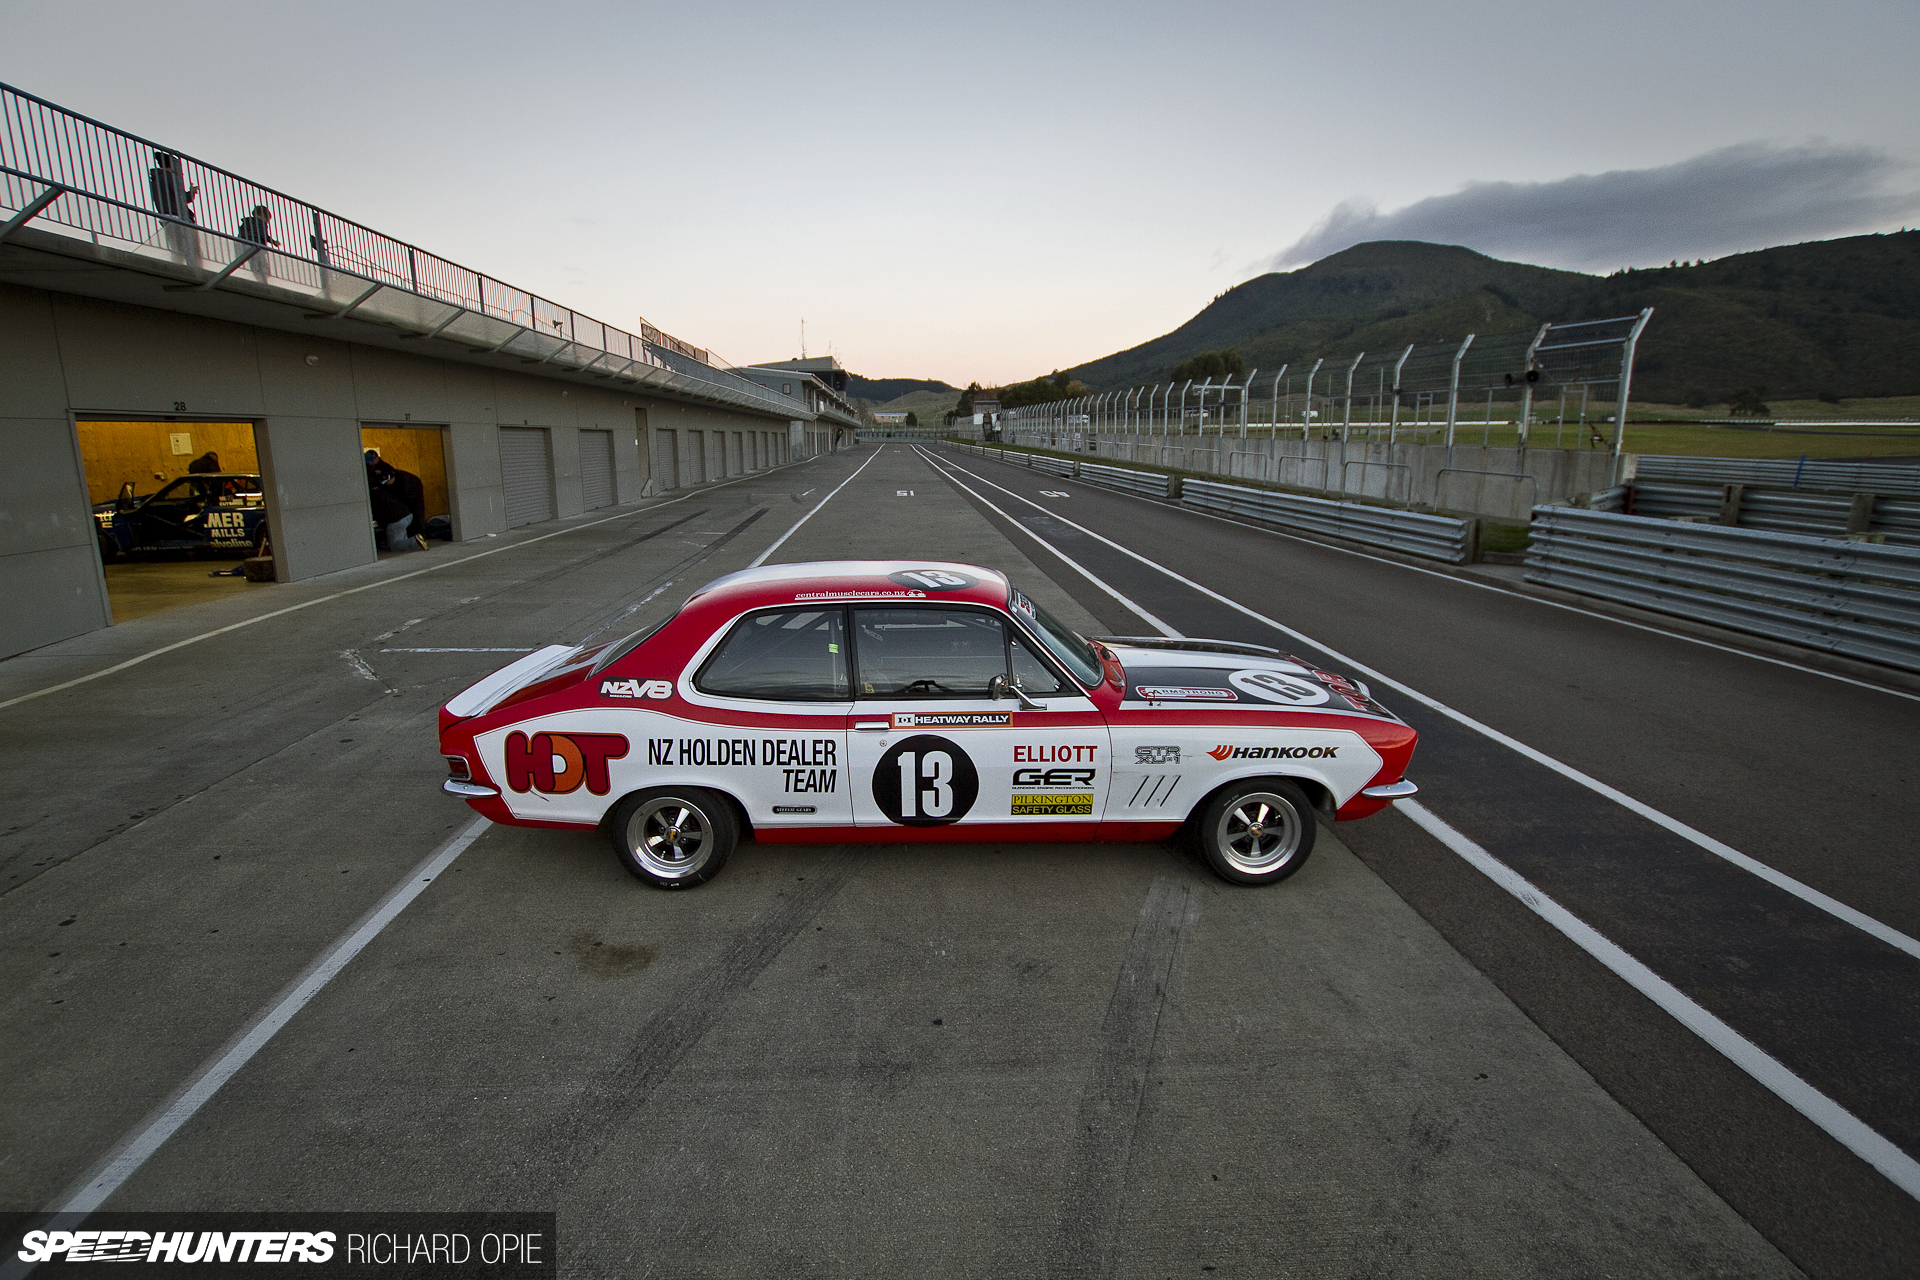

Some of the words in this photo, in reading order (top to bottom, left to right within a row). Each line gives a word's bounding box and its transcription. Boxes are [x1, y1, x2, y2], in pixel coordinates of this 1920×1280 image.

[174, 401, 187, 411] 28
[203, 512, 245, 528] MER
[211, 528, 245, 537] MILLS
[210, 539, 254, 548] alvoline
[902, 570, 966, 588] 13
[795, 590, 905, 598] centralmusclecars.co.nz
[1240, 674, 1317, 701] 13
[915, 716, 971, 724] HEATWAY
[972, 715, 1009, 723] RALLY
[648, 738, 674, 766] NZ
[679, 739, 756, 766] HOLDEN
[762, 739, 837, 766] DEALER
[1013, 745, 1098, 762] ELLIOTT
[1135, 746, 1181, 756] GTR
[504, 730, 629, 796] HDT
[783, 769, 838, 793] TEAM
[897, 750, 954, 818] 13
[1012, 768, 1096, 785] GER
[1013, 795, 1092, 804] PILKINGTON
[1012, 805, 1054, 814] SAFETY
[1055, 805, 1091, 814] GLASS
